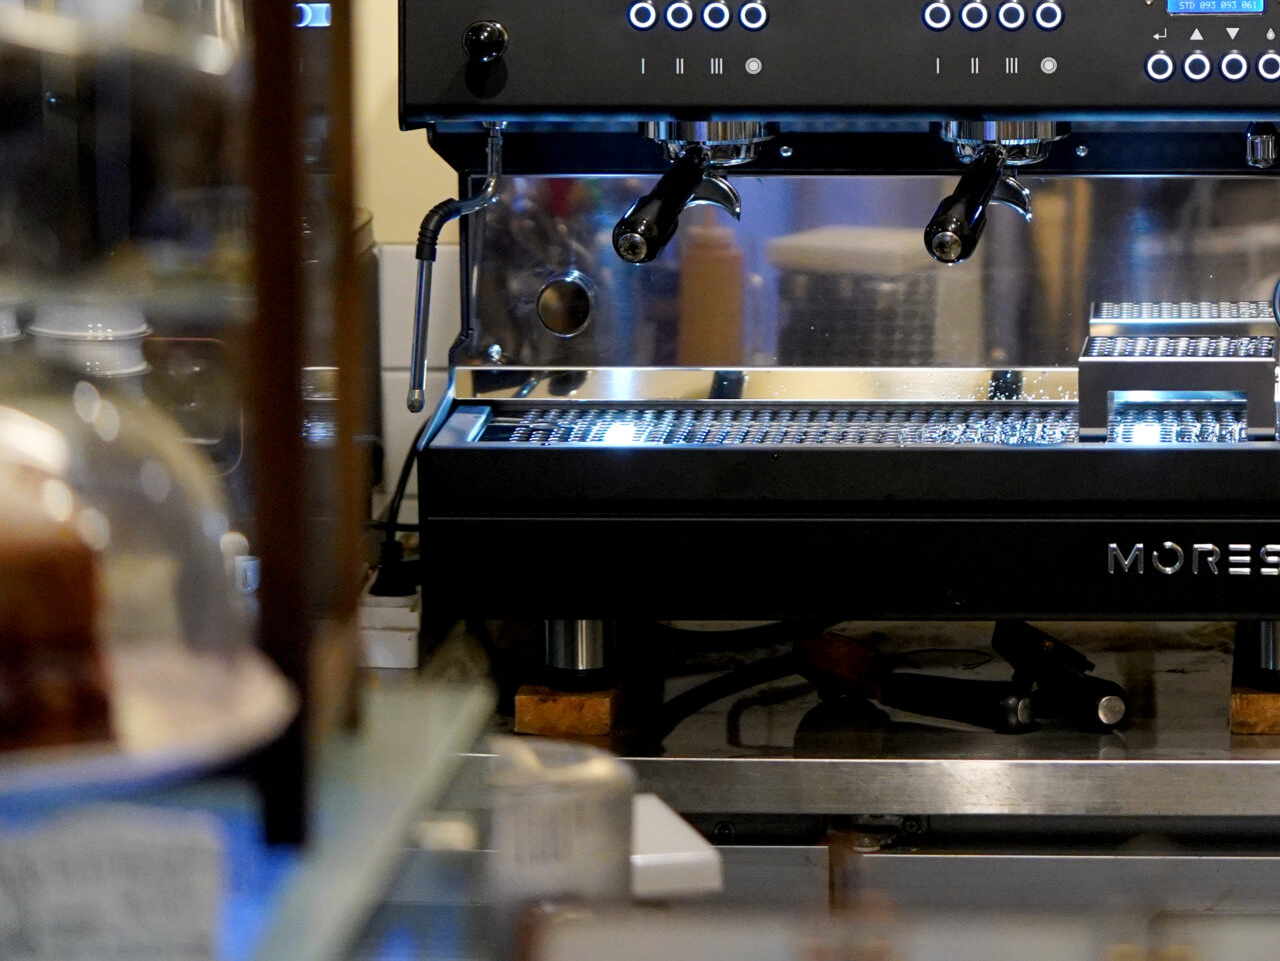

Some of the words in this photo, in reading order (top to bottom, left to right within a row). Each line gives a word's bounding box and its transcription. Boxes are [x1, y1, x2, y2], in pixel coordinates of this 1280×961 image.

[1199, 1, 1216, 9] 093
[1220, 1, 1237, 9] 093
[1241, 1, 1257, 9] 061
